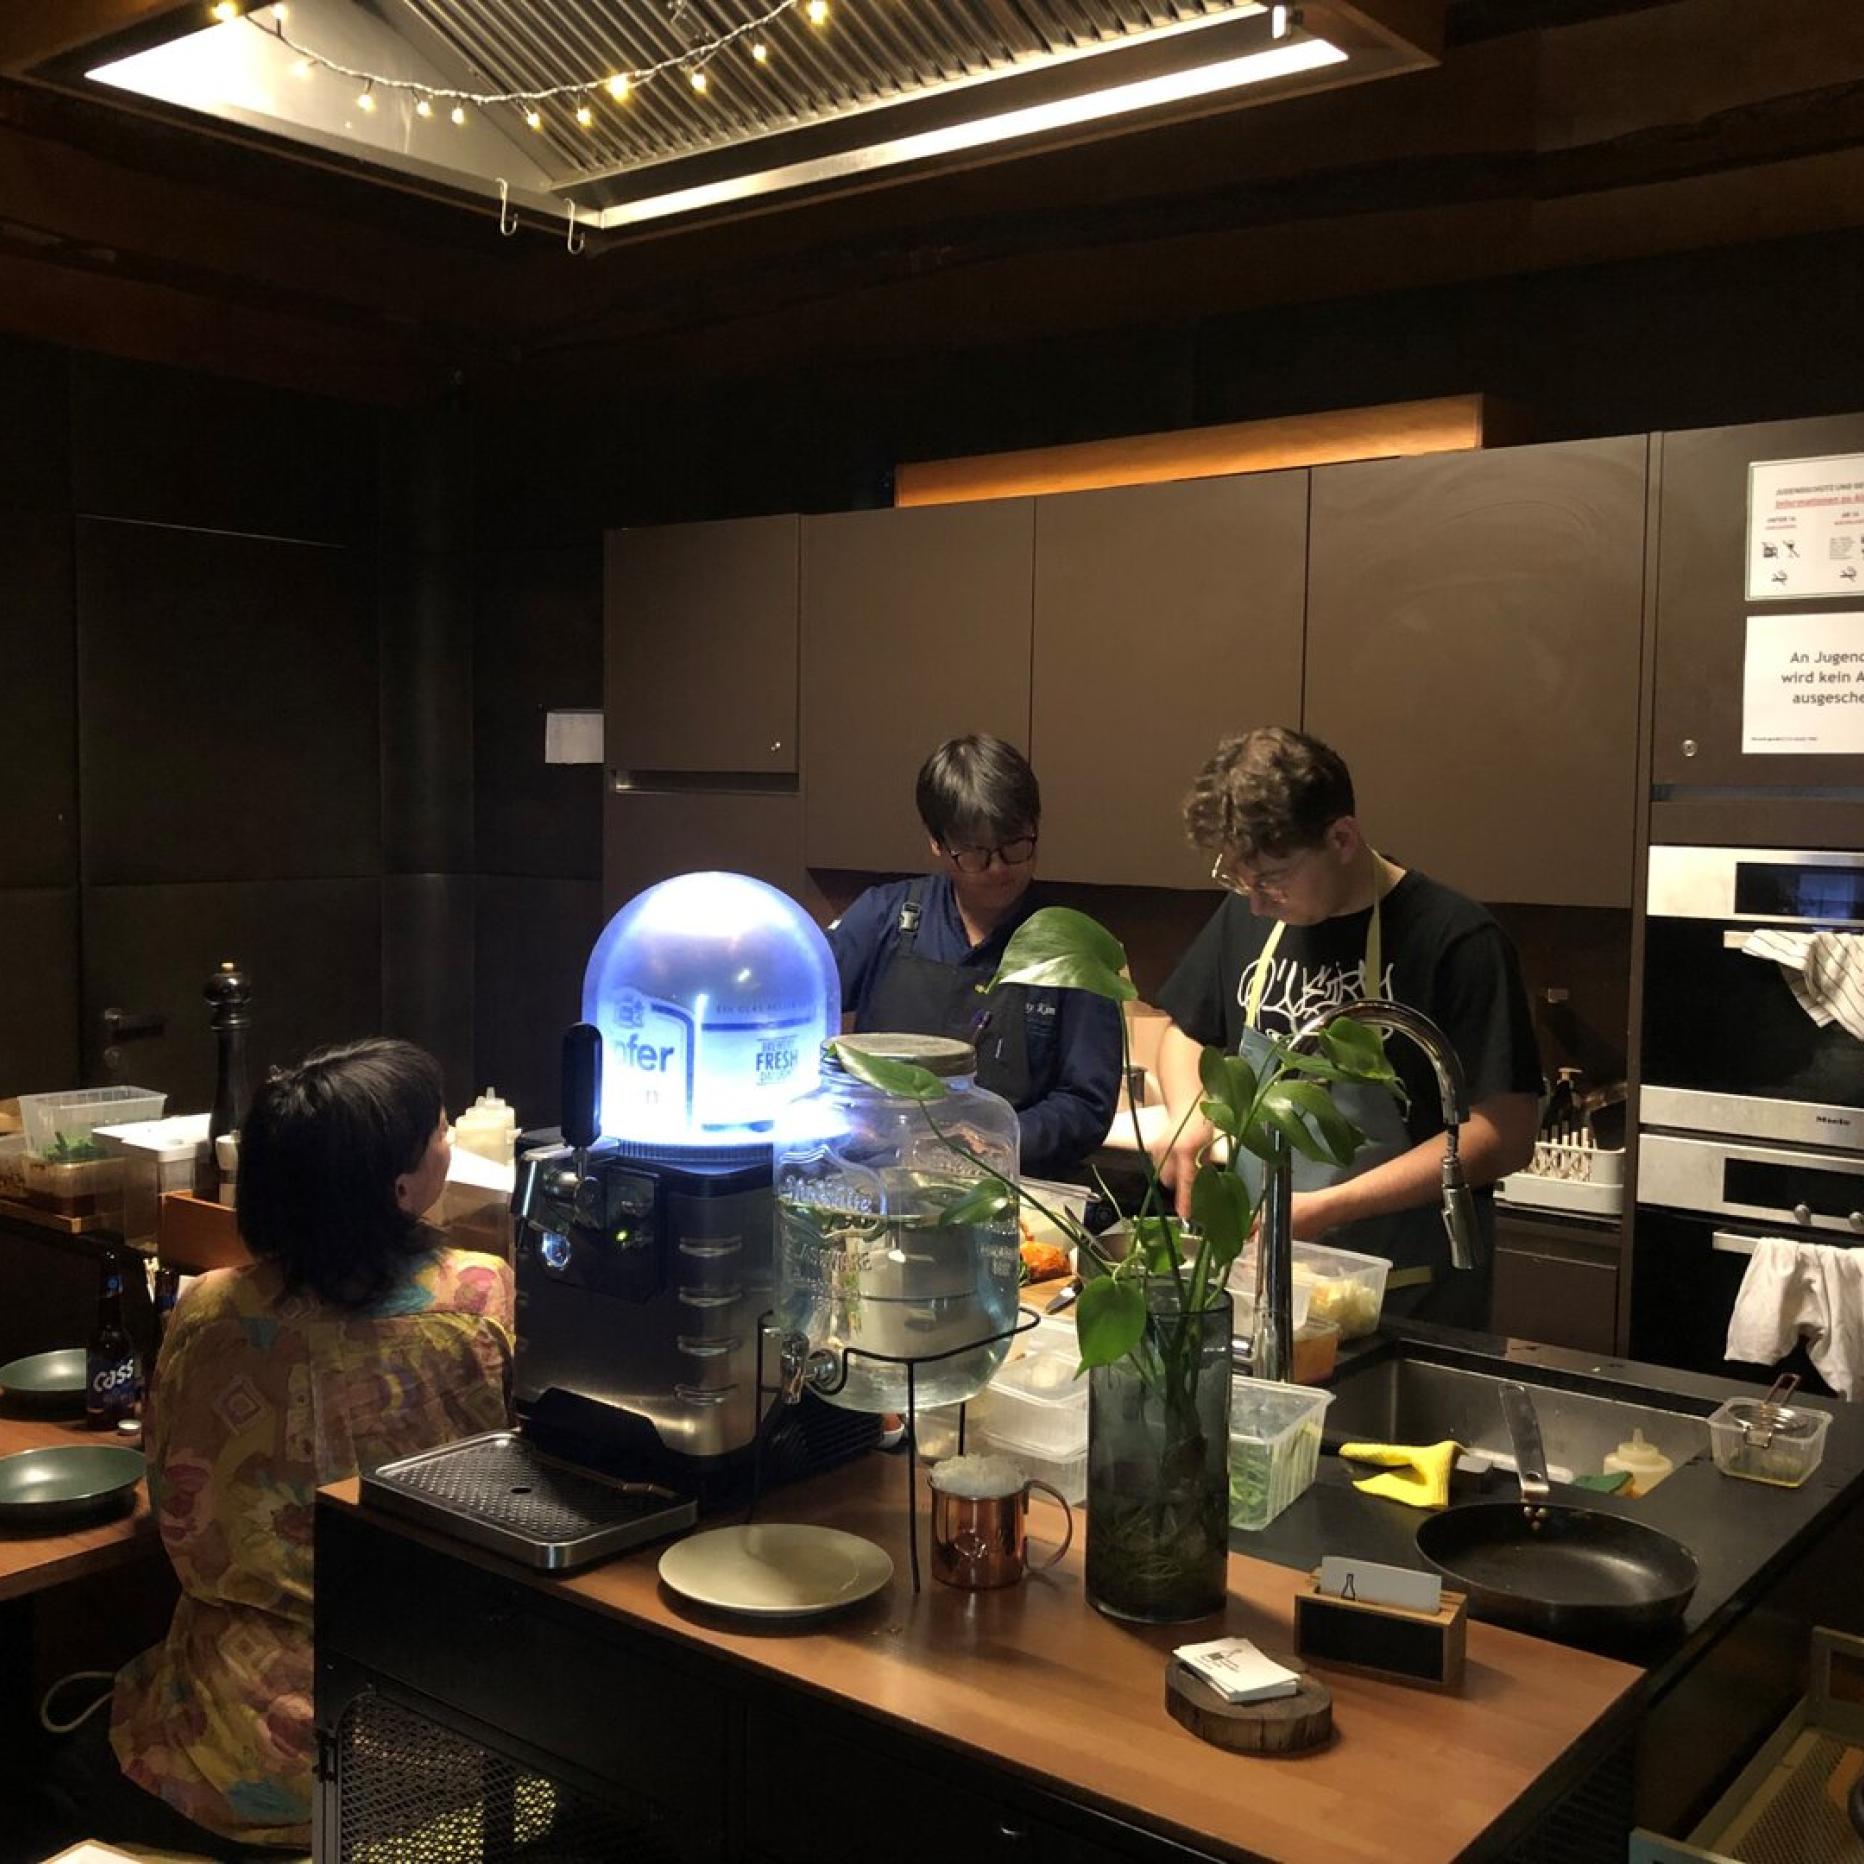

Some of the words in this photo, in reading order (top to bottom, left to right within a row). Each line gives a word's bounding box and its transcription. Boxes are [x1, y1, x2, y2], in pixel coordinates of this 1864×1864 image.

[1790, 651, 1810, 664] An
[1781, 671, 1814, 684] wird
[1819, 671, 1852, 684] kein
[756, 1050, 798, 1072] FRESH
